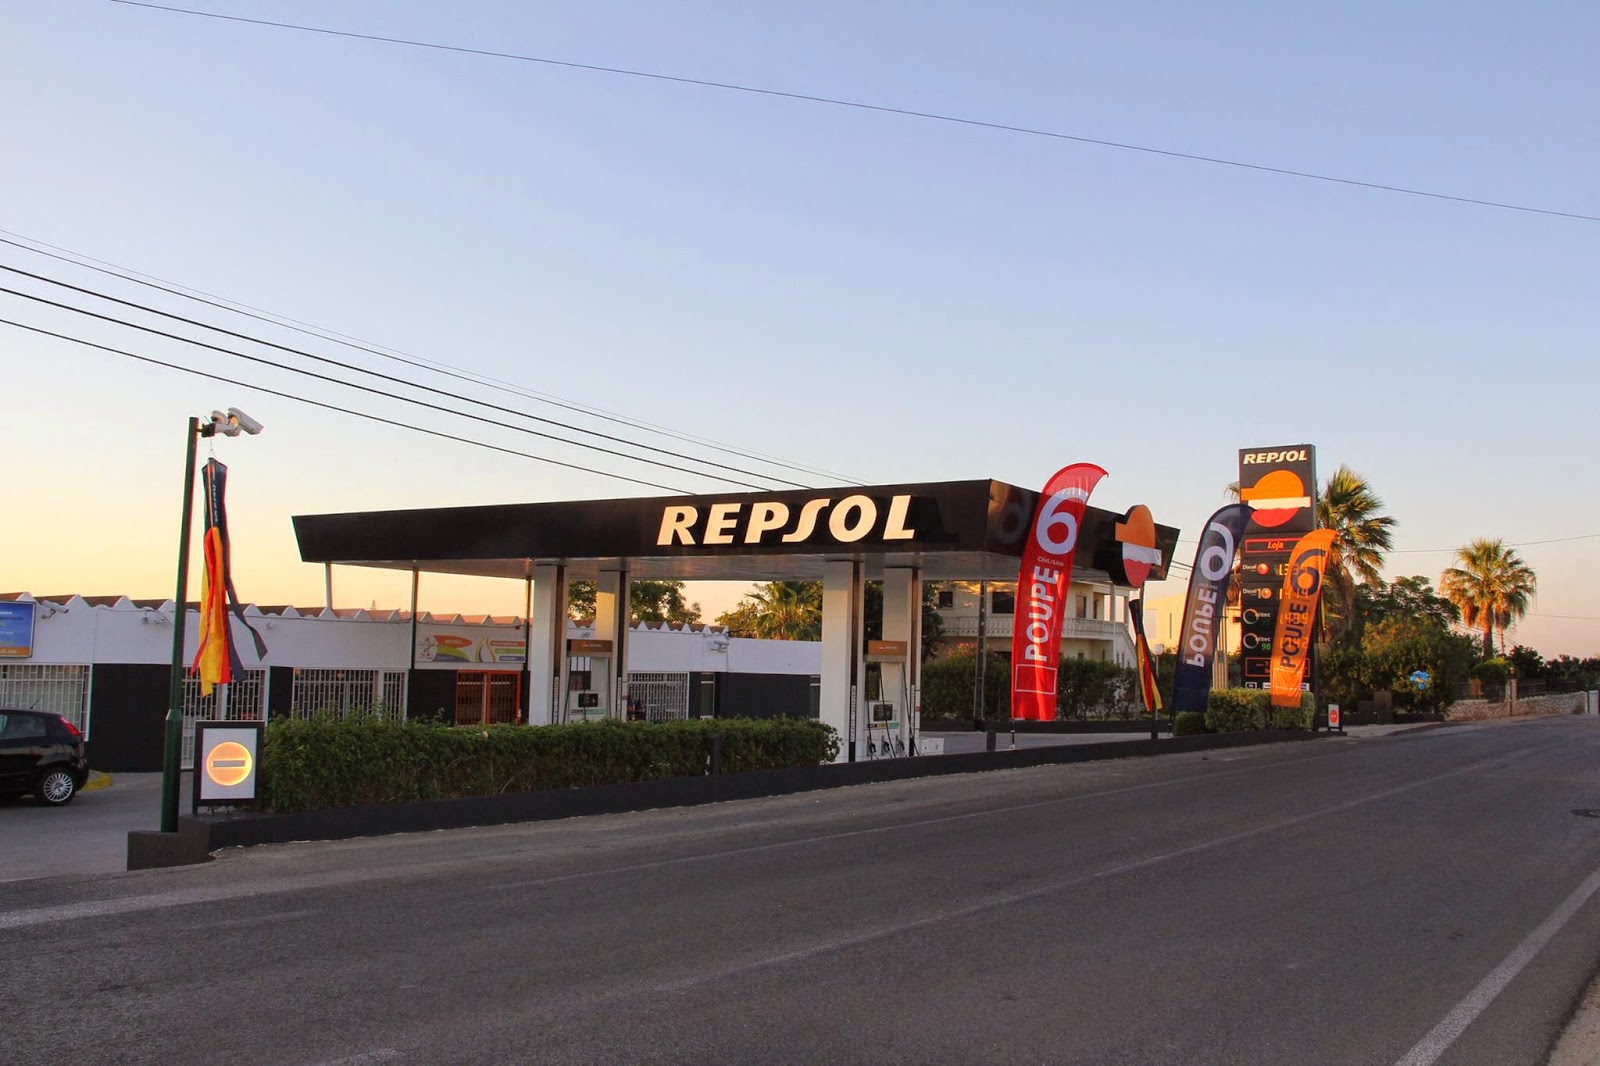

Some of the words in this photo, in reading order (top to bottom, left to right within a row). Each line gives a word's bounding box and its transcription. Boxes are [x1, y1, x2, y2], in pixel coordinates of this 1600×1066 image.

[1243, 450, 1308, 465] REPSOL
[657, 494, 915, 546] REPSOL
[1036, 487, 1089, 555] 6
[1267, 541, 1284, 551] Loja
[1290, 548, 1326, 596] 6
[1024, 565, 1059, 662] POUPE
